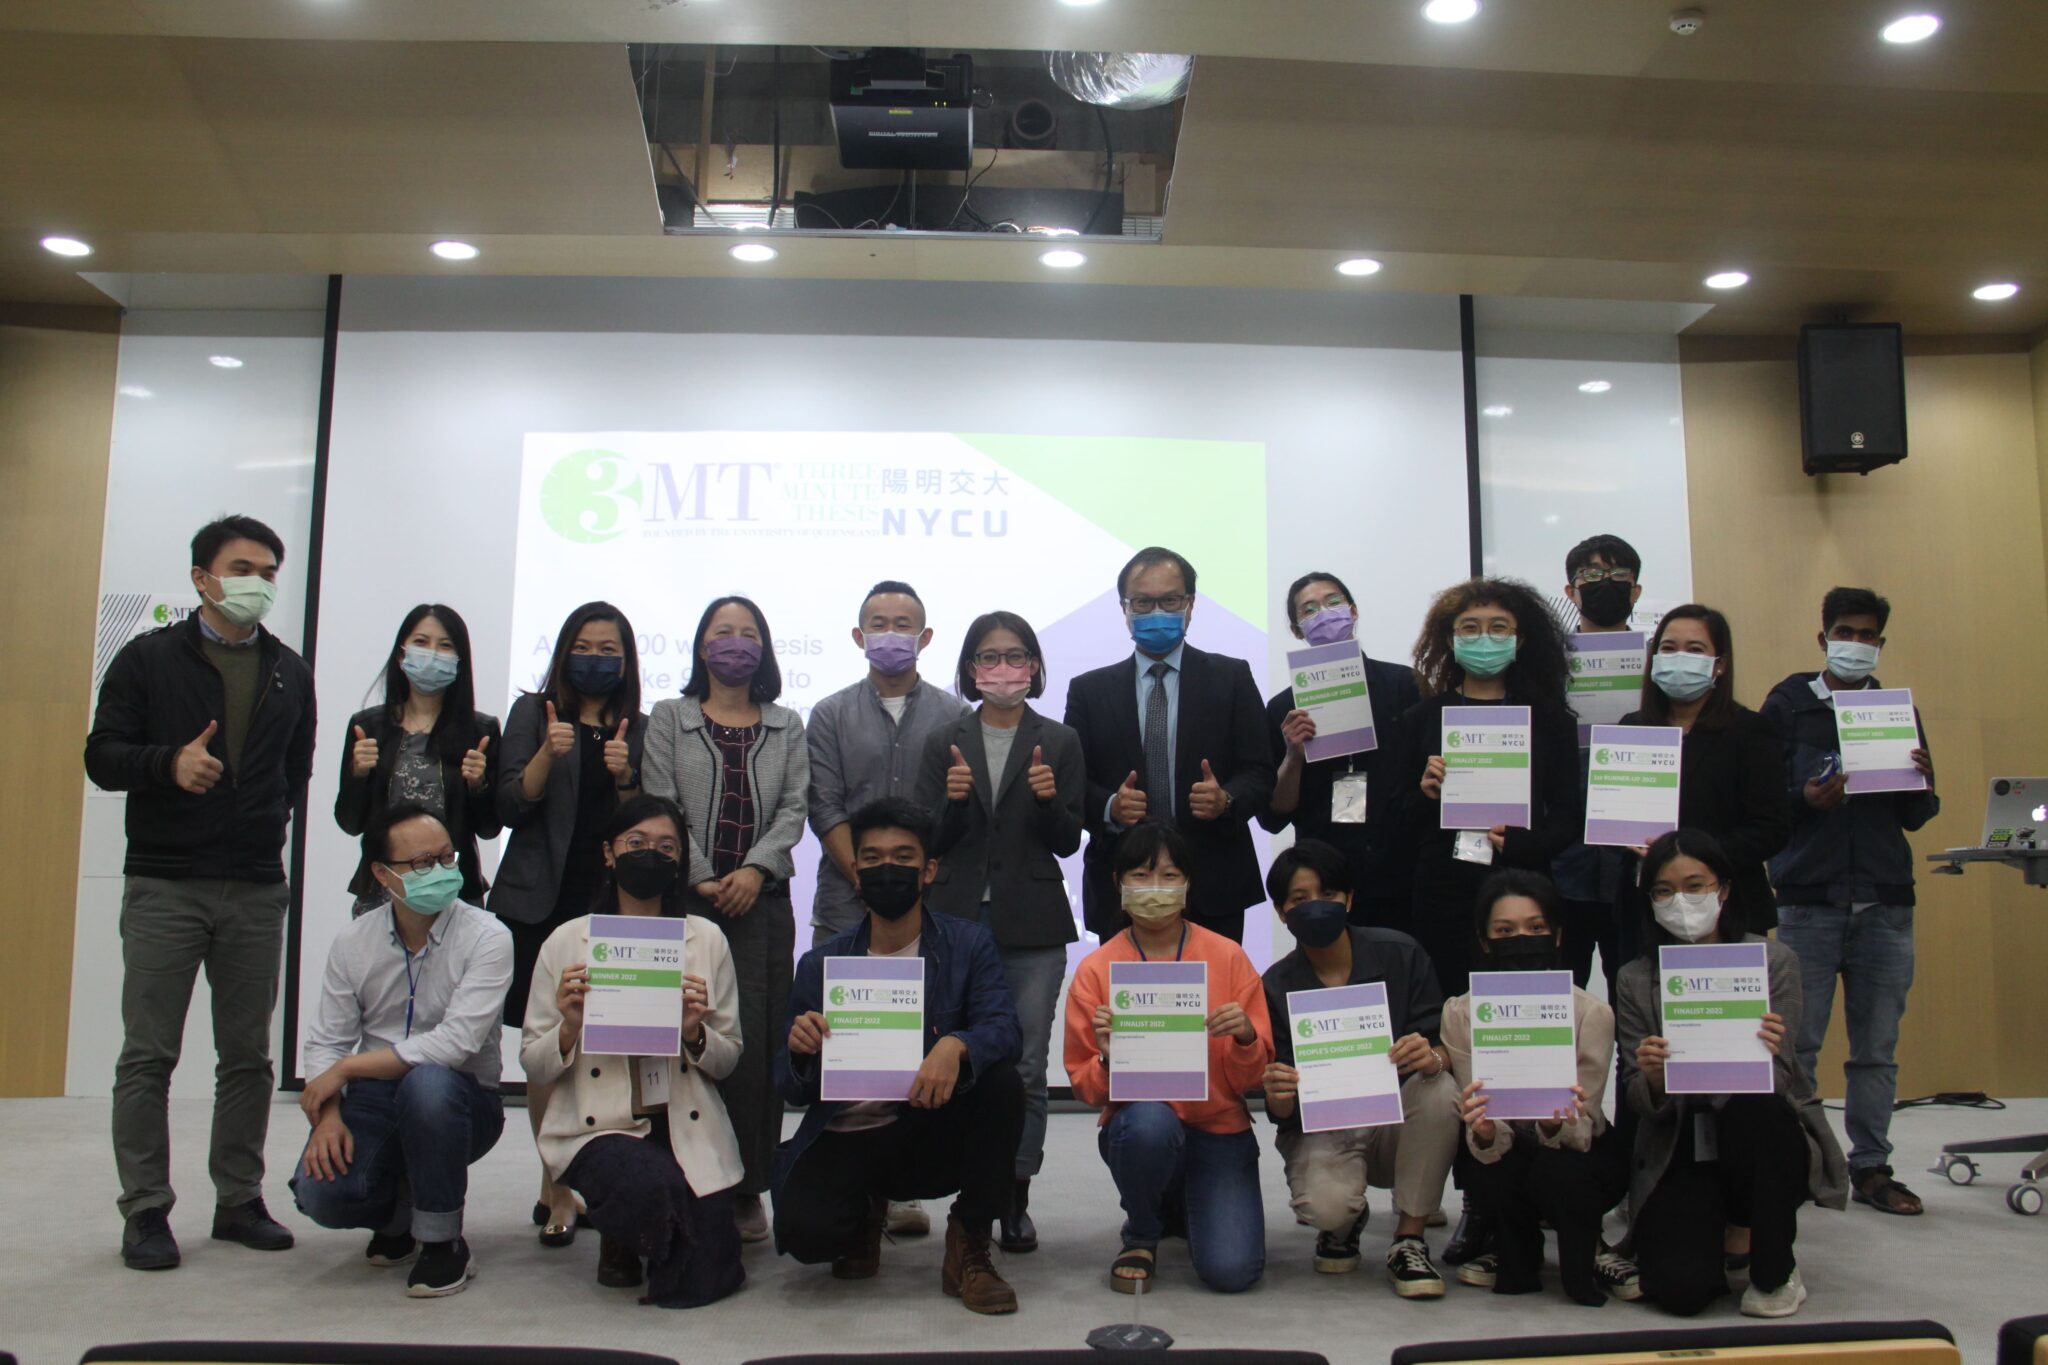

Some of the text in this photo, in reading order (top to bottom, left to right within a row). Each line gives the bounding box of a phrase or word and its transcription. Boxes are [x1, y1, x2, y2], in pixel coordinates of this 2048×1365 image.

[882, 468, 1009, 496] 陽明交大
[794, 503, 880, 522] THESIS
[882, 508, 1008, 538] NYCU
[774, 634, 823, 656] esis
[642, 668, 671, 689] ke
[787, 669, 811, 689] to
[1345, 796, 1353, 808] 7
[1474, 838, 1482, 849] 4
[591, 972, 637, 981] WINNER 2022
[864, 1017, 880, 1025] 2022
[1540, 1012, 1567, 1020] NYCU
[1149, 1020, 1166, 1028] 2022
[1359, 1022, 1385, 1030] NYCU
[1330, 1044, 1355, 1054] CHOICE
[1356, 1042, 1373, 1051] 2022
[647, 1071, 659, 1086] 11
